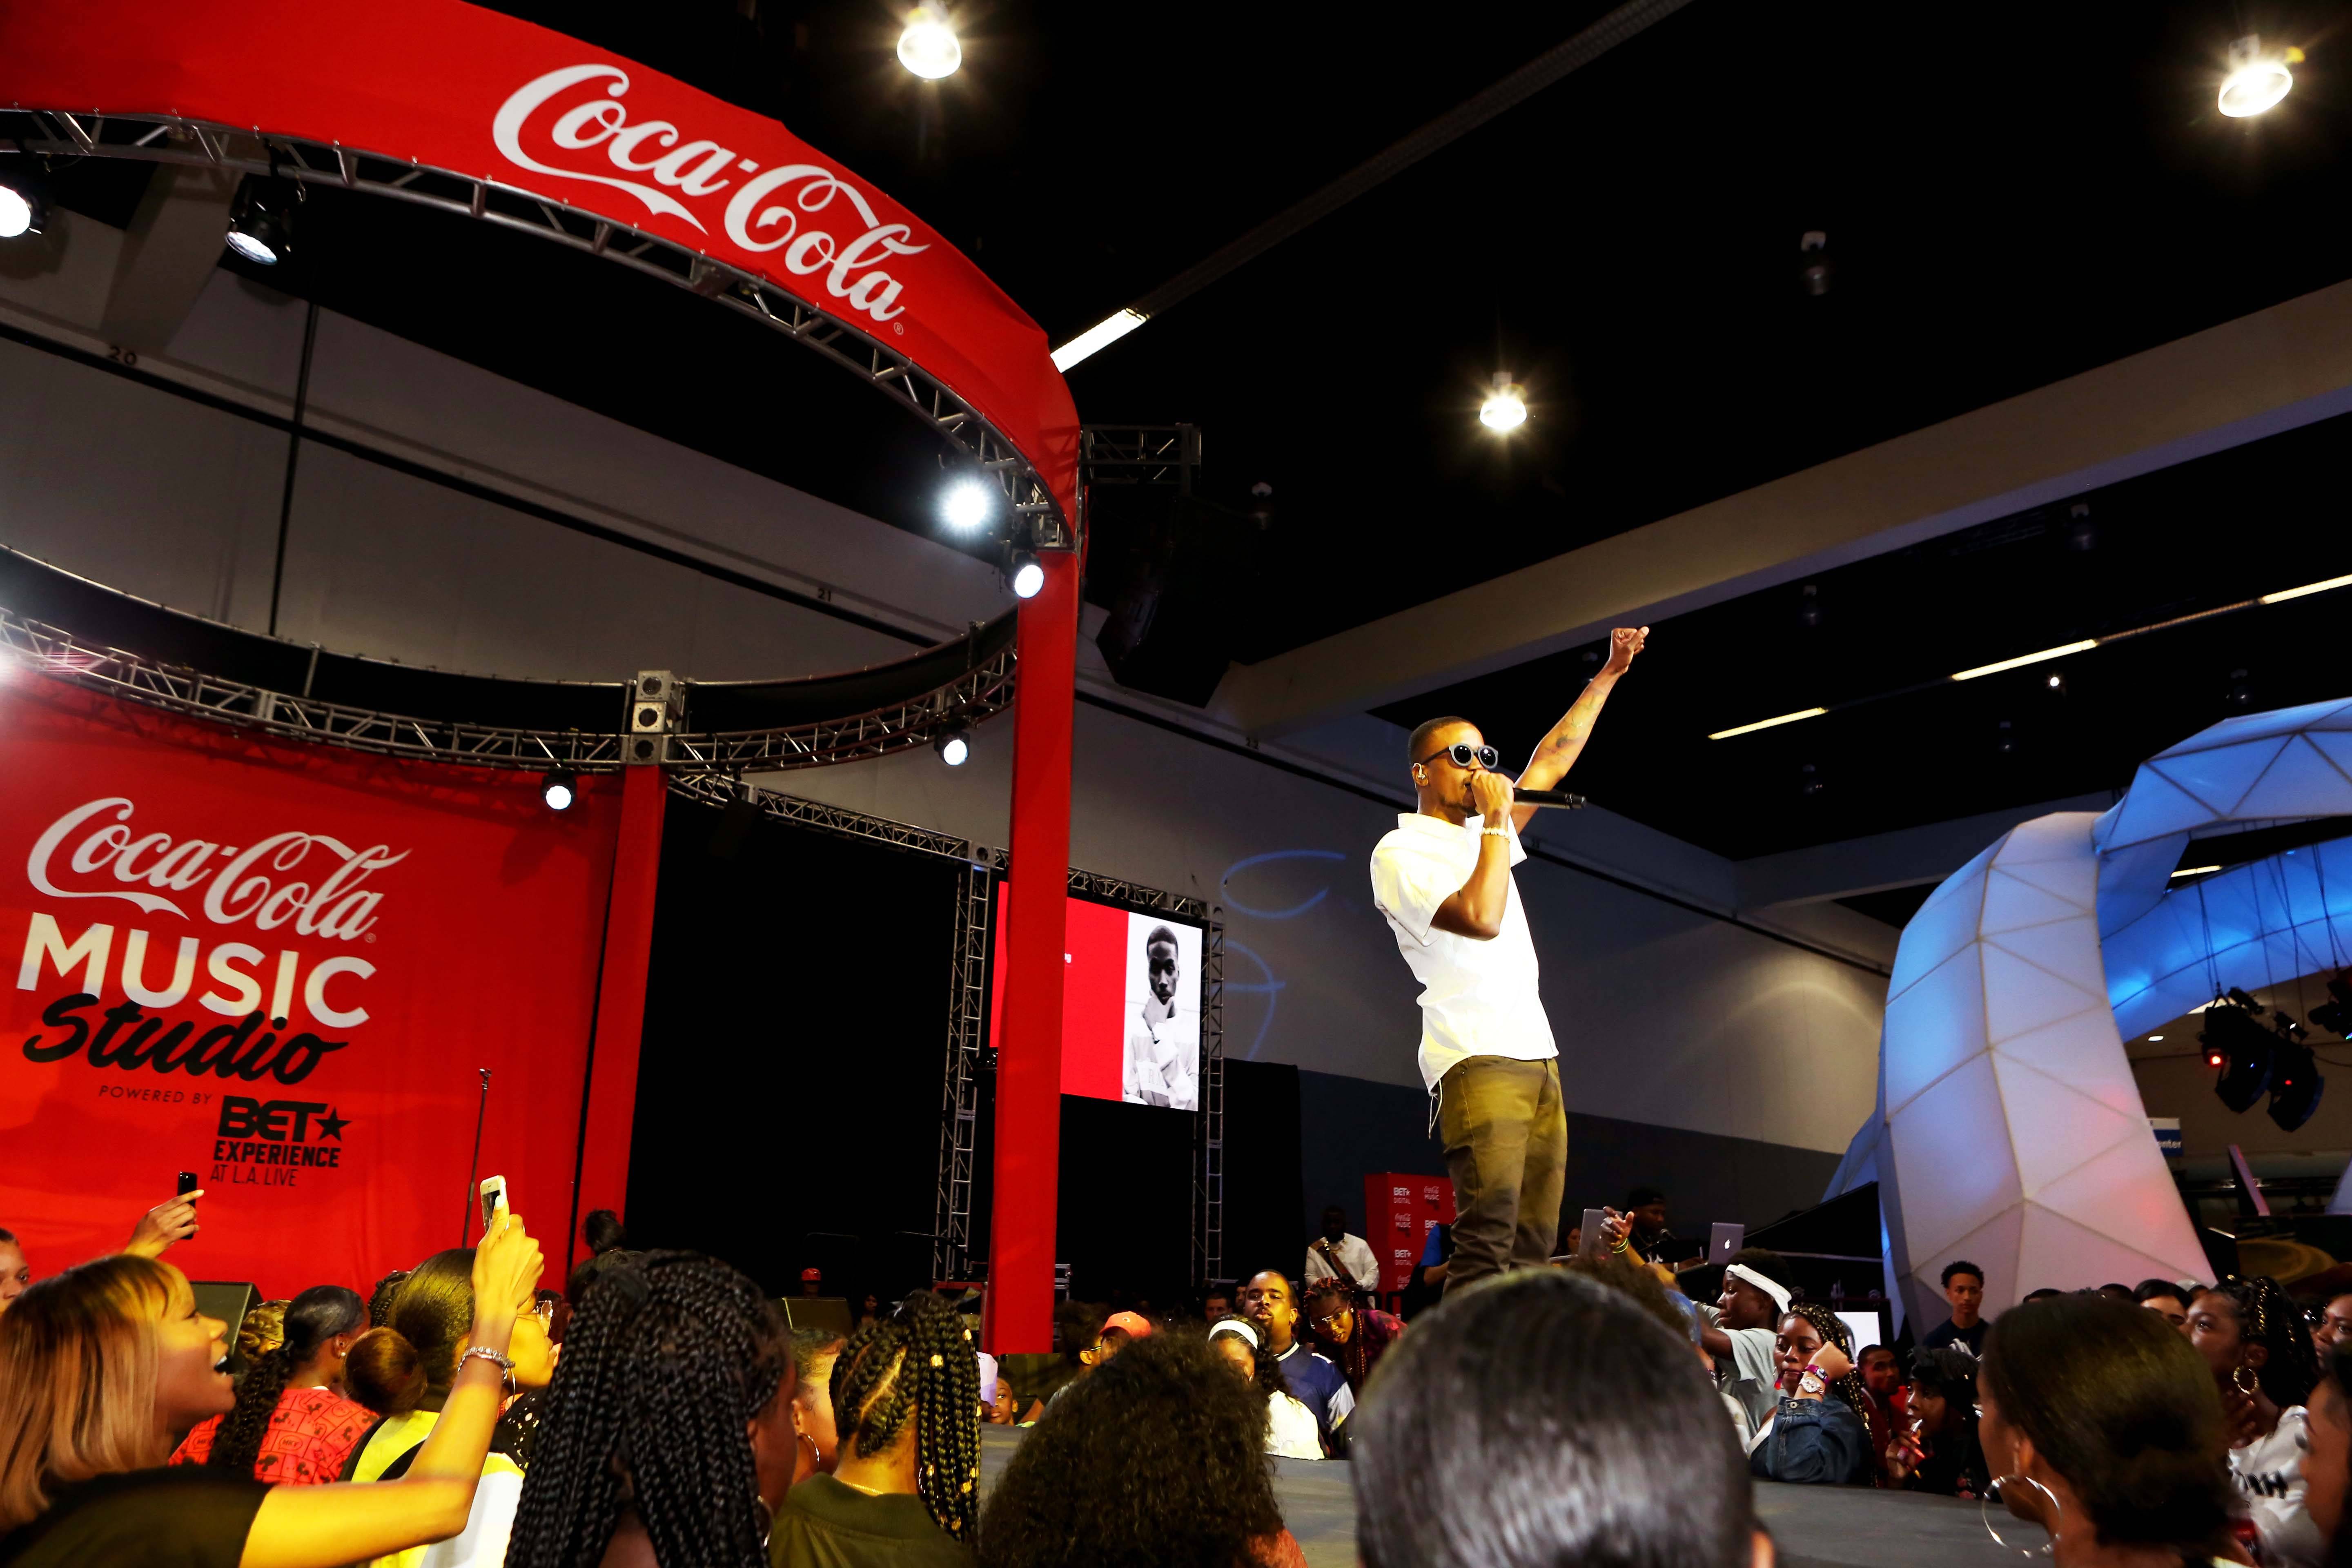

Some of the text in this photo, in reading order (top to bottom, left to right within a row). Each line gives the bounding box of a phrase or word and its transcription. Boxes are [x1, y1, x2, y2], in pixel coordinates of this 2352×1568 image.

[492, 64, 931, 322] Coca-Cola
[109, 346, 137, 366] 20
[818, 588, 831, 601] 21
[27, 797, 412, 940] Coca-Cola
[16, 911, 377, 1028] MUSIC
[22, 993, 349, 1085] Studio
[98, 1085, 212, 1105] POWERED BY
[217, 1095, 328, 1143] BET
[213, 1140, 342, 1167] EXPERIENCE
[210, 1165, 299, 1186] AT L.A. LIVE
